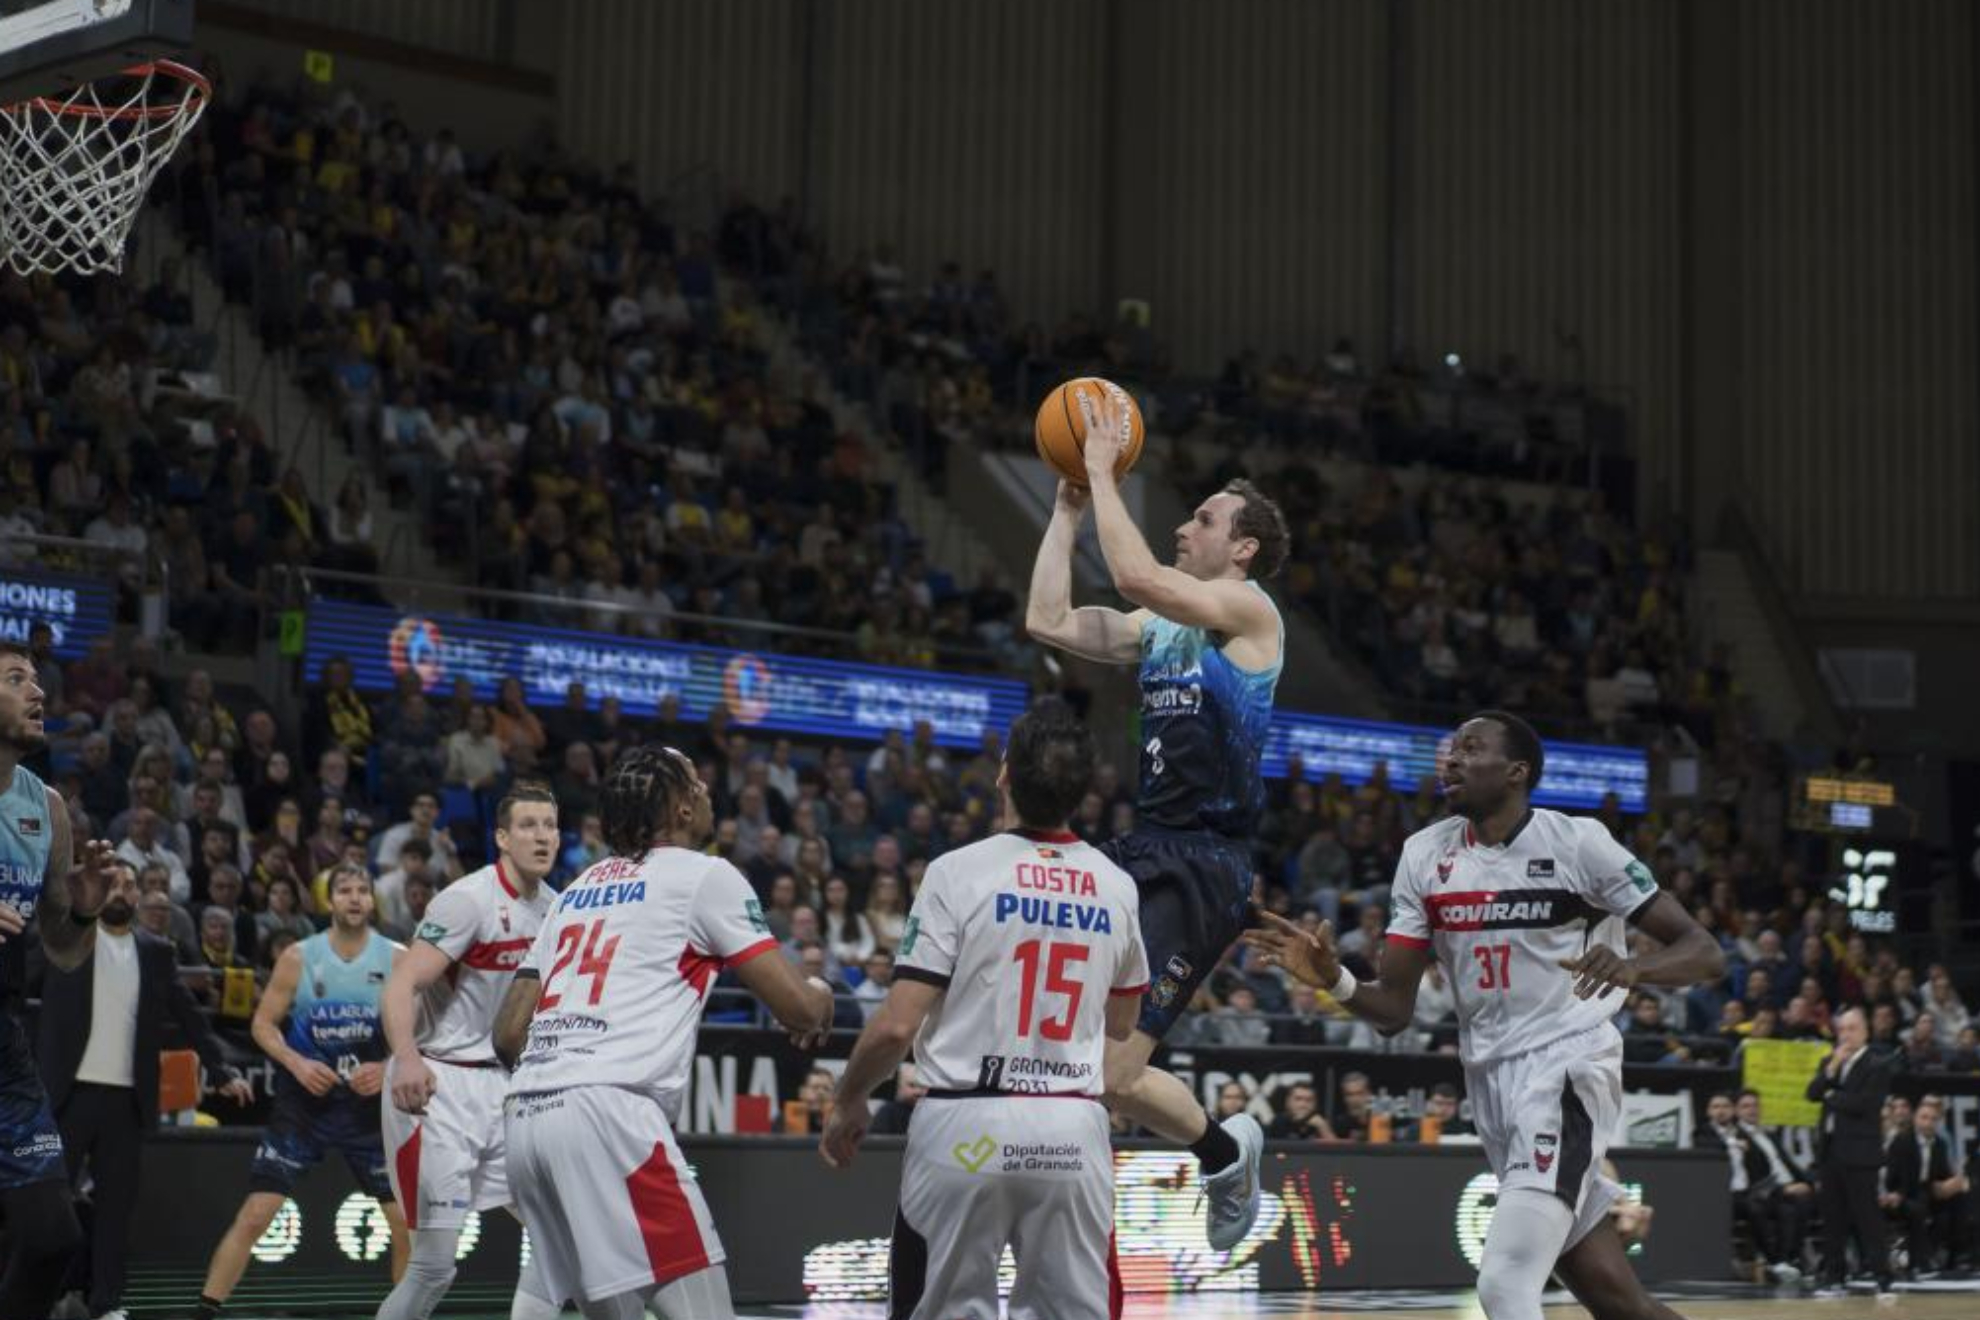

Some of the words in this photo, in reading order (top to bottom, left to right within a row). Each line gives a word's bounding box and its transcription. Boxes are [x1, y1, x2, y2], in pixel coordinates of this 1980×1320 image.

[1016, 863, 1098, 897] COSTA
[559, 881, 646, 914] PULEVA
[996, 893, 1112, 935] PULEVA
[1438, 894, 1553, 924] COVIRAN
[536, 918, 622, 1014] 24
[1473, 943, 1512, 990] 37
[1014, 939, 1090, 1041] 15
[311, 1021, 374, 1039] tenerife
[1003, 1142, 1082, 1159] Diputación
[1003, 1160, 1021, 1171] de
[1025, 1157, 1083, 1172] Granada
